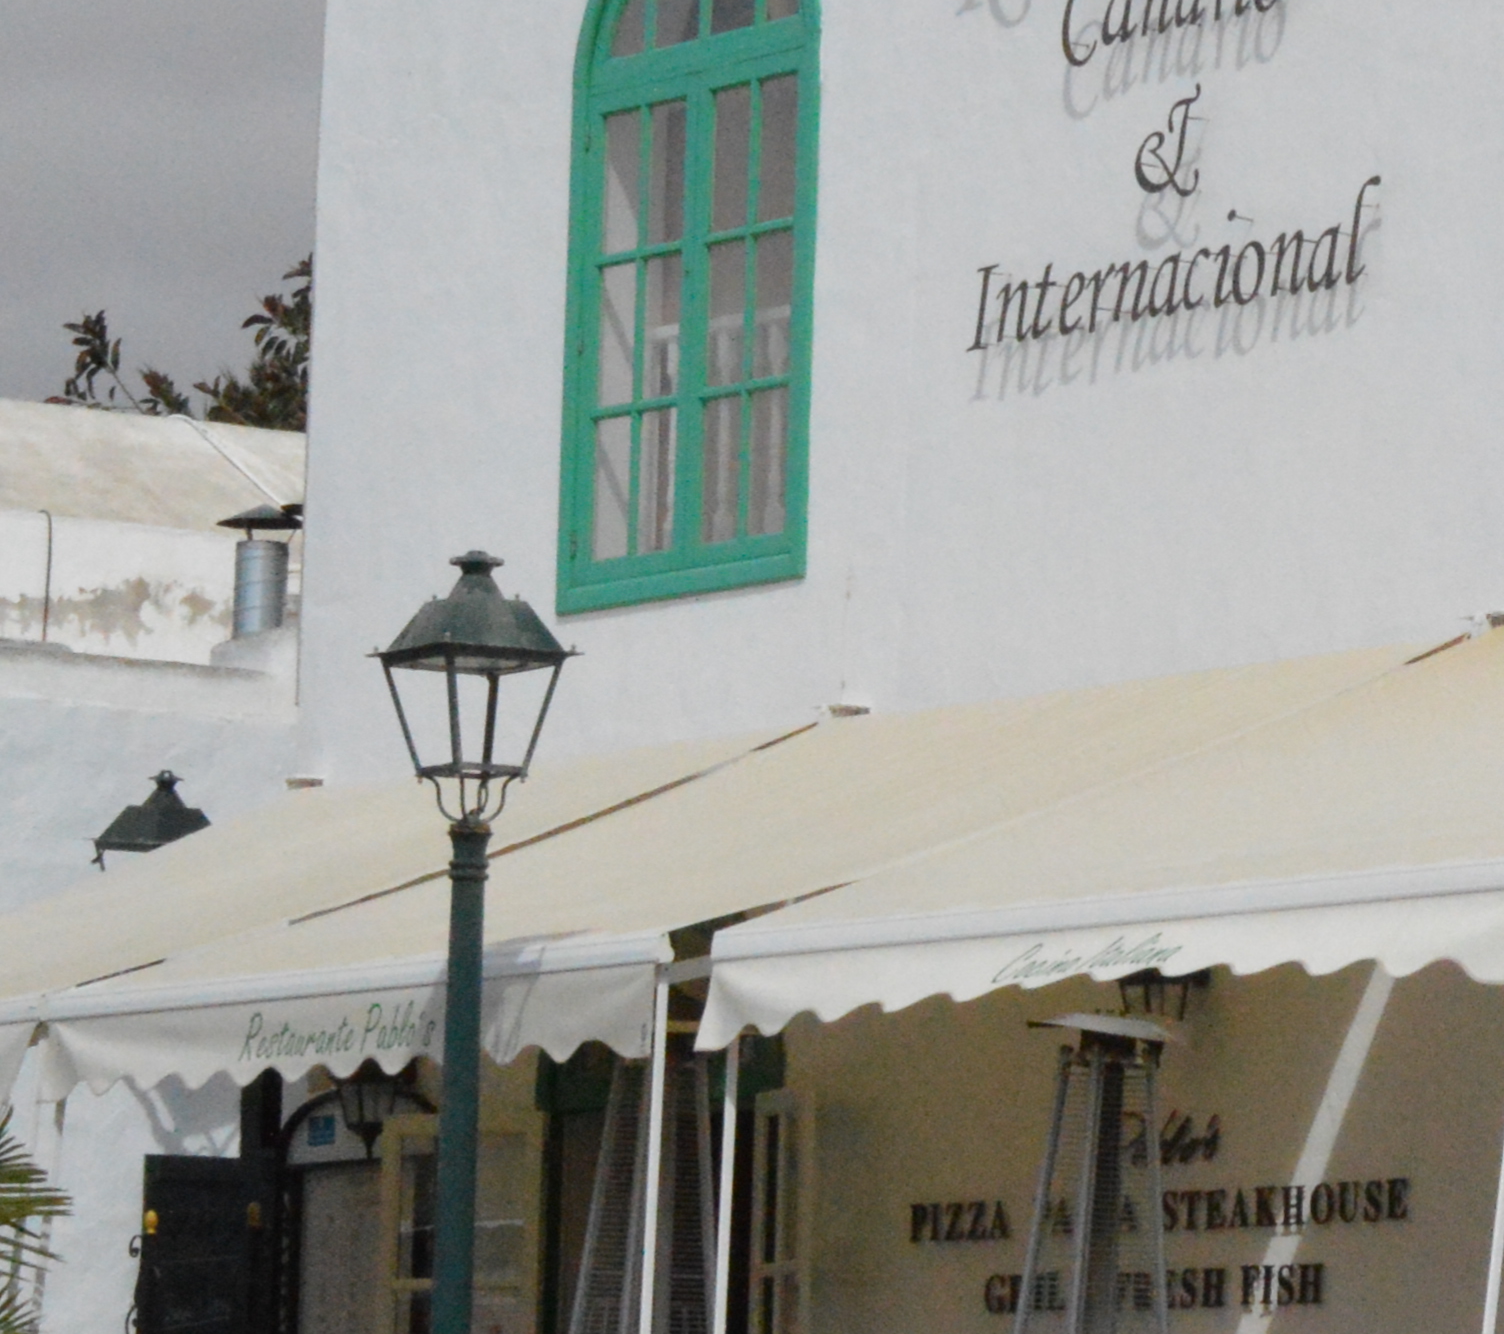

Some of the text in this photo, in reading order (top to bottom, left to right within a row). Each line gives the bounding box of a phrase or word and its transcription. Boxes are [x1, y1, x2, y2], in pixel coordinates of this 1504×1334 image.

[1133, 83, 1202, 197] &
[966, 175, 1383, 354] Internacional
[239, 999, 438, 1062] Restaurante Pablo's
[909, 1199, 1011, 1244] PIZZA
[1161, 1177, 1411, 1232] STEAKHOUSE
[1240, 1263, 1325, 1309] FISH
